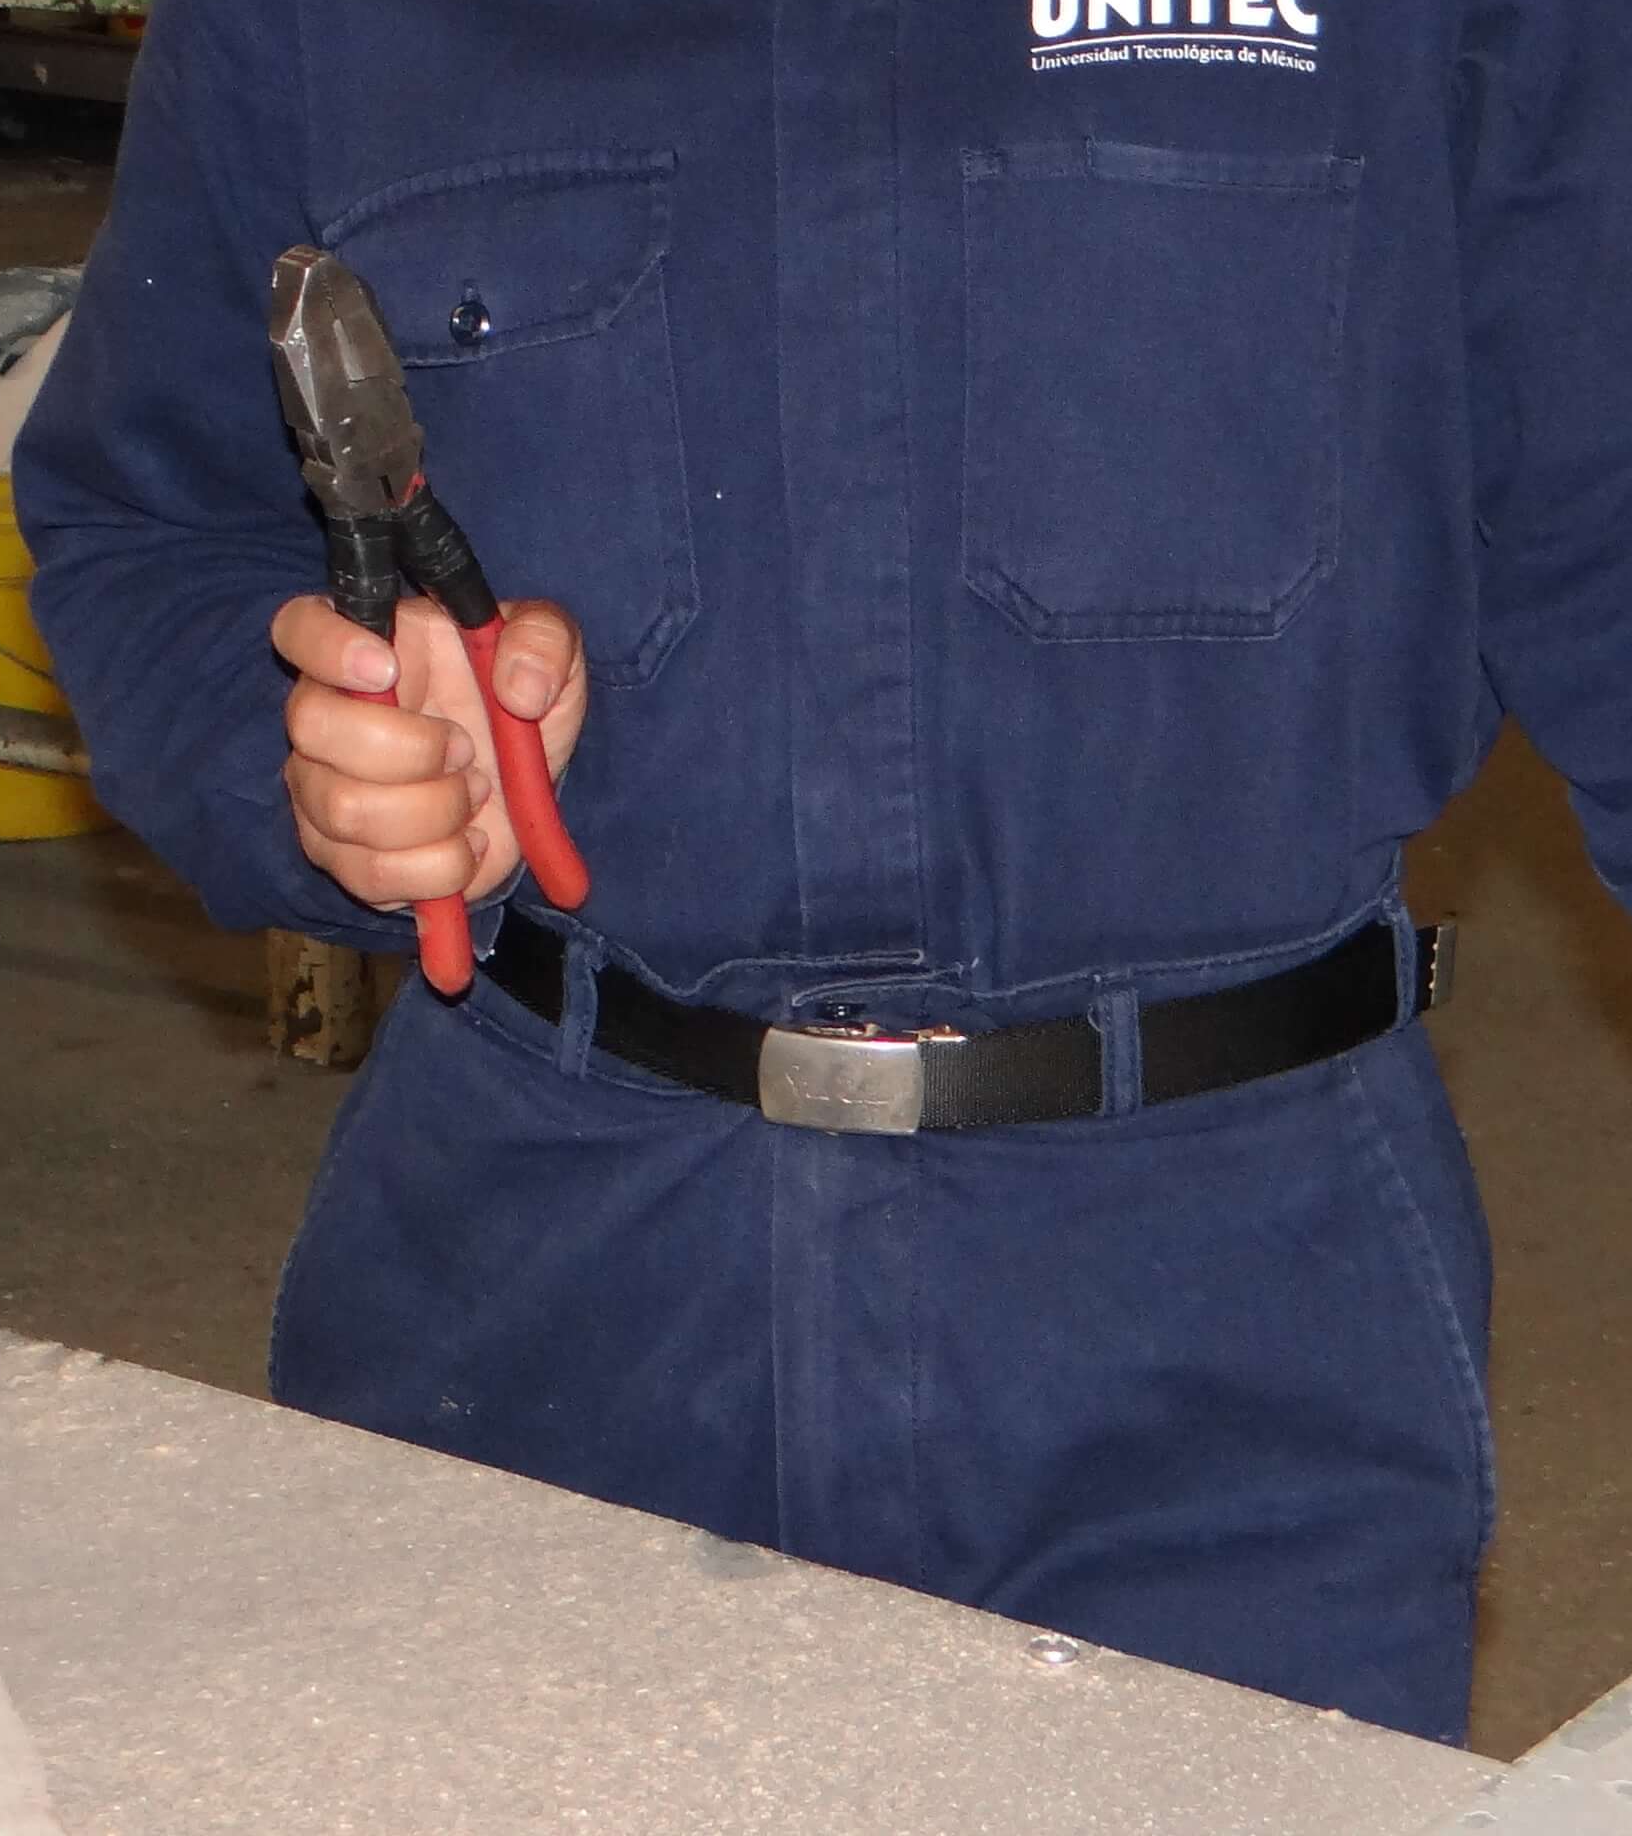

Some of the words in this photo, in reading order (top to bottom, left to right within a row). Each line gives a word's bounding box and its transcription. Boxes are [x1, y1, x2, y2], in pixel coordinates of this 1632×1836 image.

[1030, 44, 1129, 71] Universidad
[1132, 43, 1234, 64] Tecnológica
[1237, 45, 1257, 64] de
[1261, 46, 1316, 73] México
